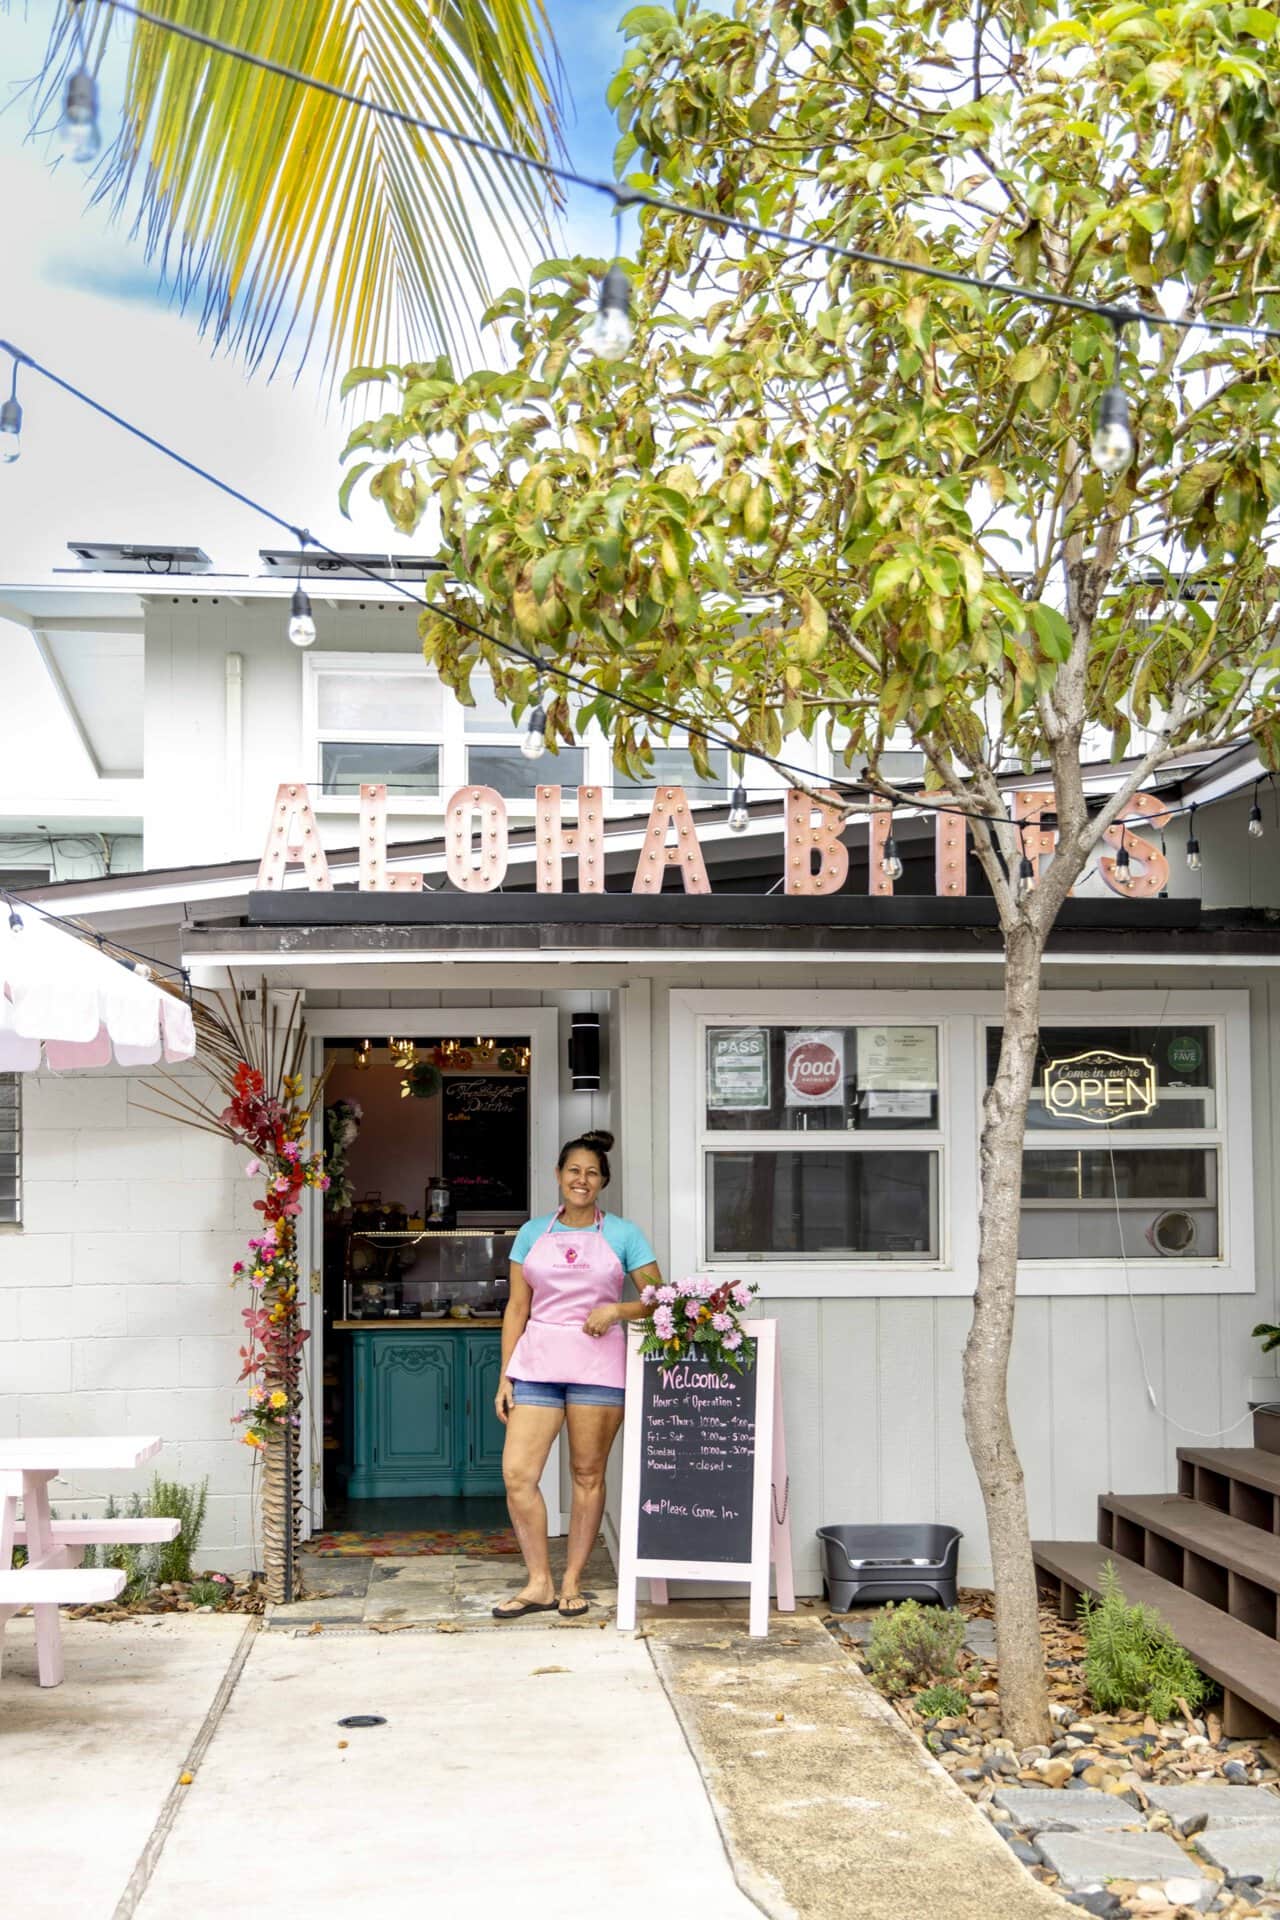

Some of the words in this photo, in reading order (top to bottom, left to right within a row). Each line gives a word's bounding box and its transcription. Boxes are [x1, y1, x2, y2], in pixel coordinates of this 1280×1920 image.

[256, 783, 712, 893] ALOHA
[718, 1041, 760, 1053] PASS
[1174, 1051, 1196, 1061] FAVE
[791, 1054, 838, 1083] food
[1058, 1064, 1090, 1079] Come
[1109, 1065, 1140, 1078] we're
[1051, 1078, 1151, 1107] OPEN
[653, 1394, 680, 1408] Hours
[660, 1499, 689, 1516] Please
[692, 1503, 718, 1519] Come
